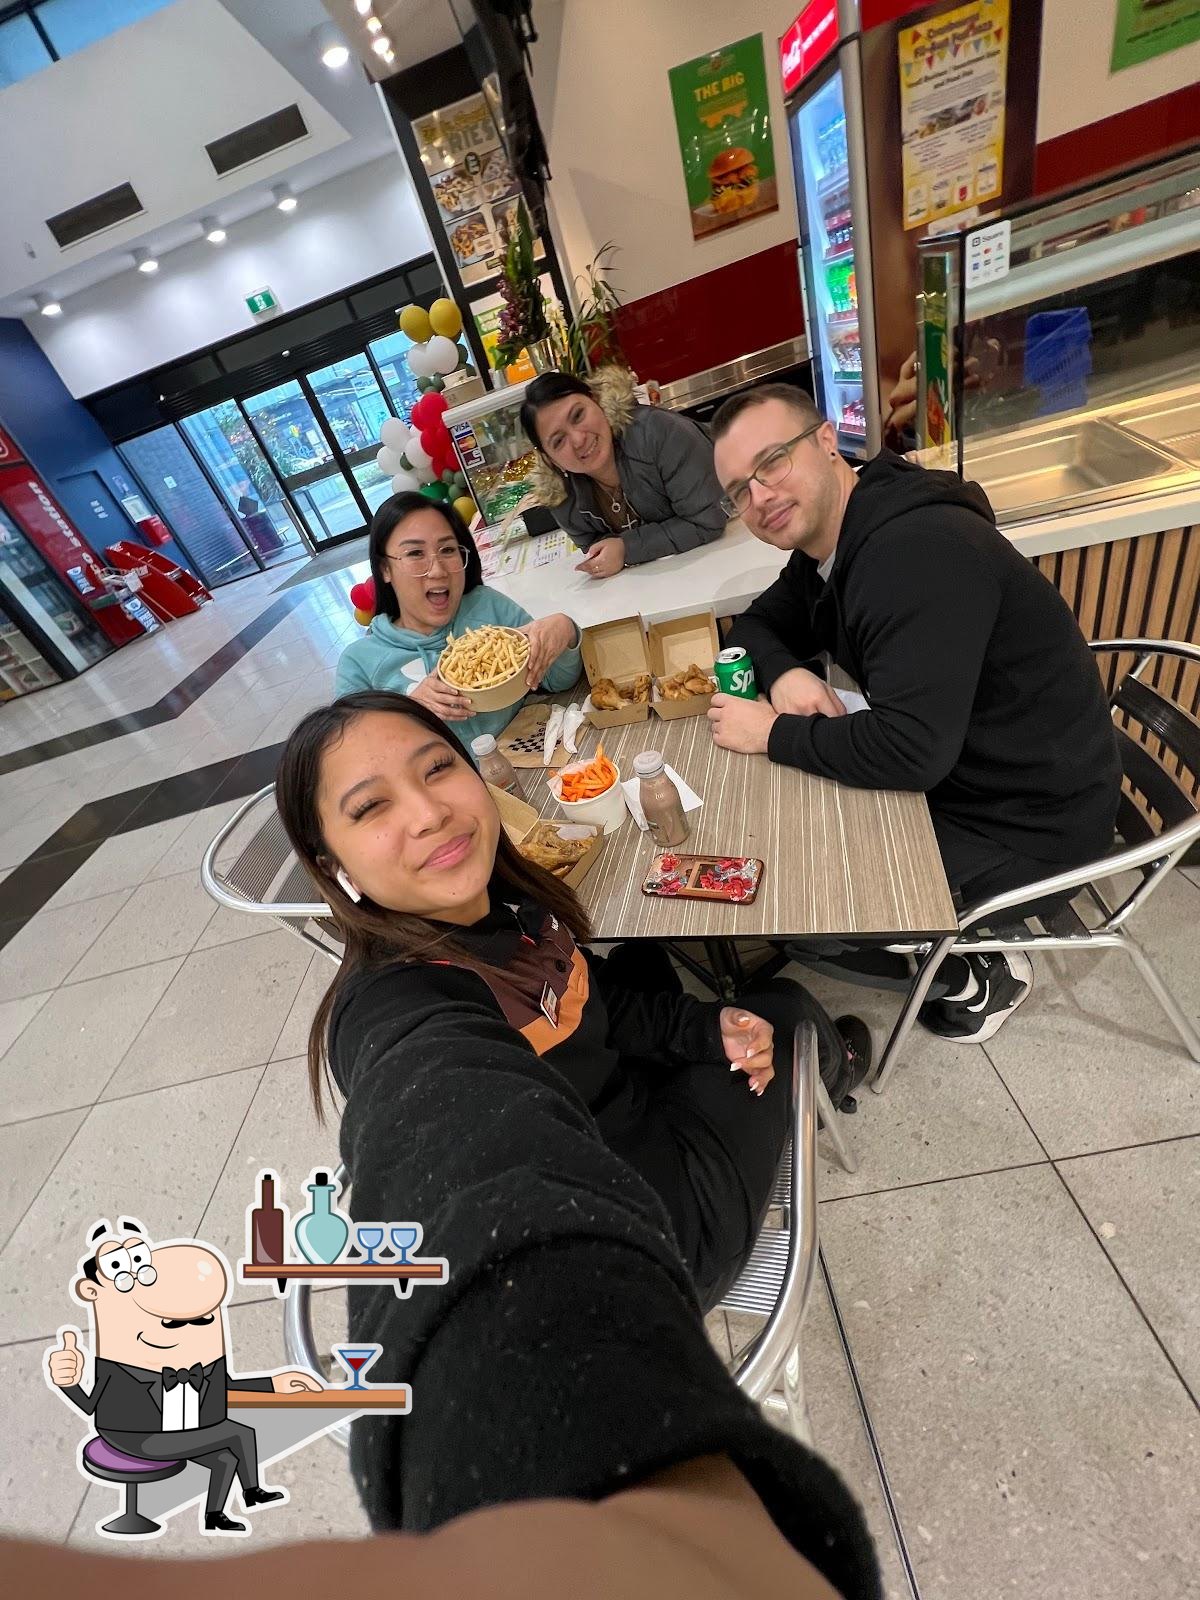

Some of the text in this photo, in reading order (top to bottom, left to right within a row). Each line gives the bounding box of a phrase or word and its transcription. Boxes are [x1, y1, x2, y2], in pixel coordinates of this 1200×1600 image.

[693, 72, 745, 103] THE BIG
[453, 421, 470, 433] VISA
